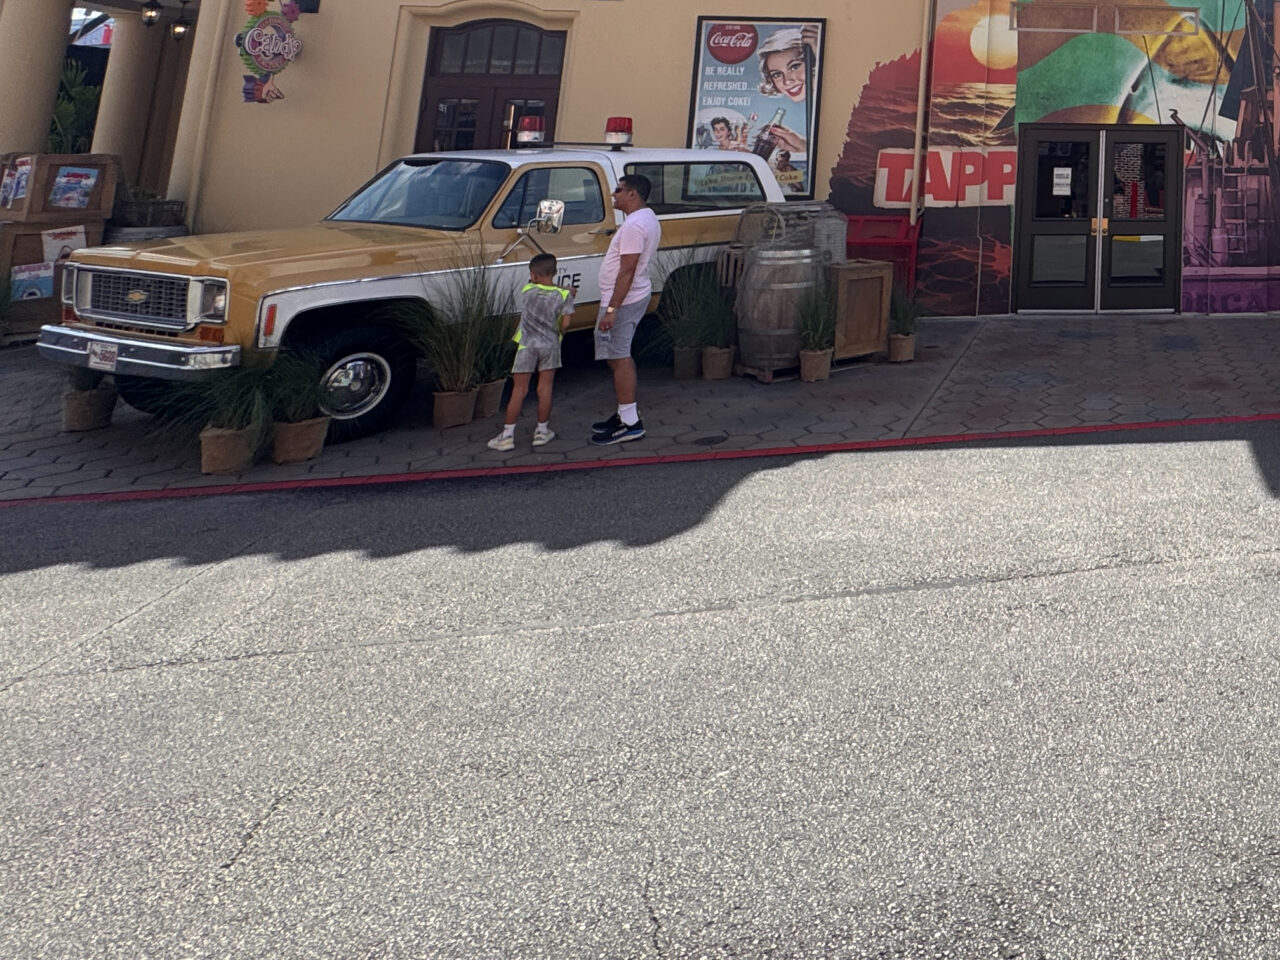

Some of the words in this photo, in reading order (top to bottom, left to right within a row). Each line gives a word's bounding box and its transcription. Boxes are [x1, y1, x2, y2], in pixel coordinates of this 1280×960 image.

[245, 28, 302, 61] Candy
[705, 66, 714, 76] BE
[717, 66, 745, 76] REALLY
[702, 96, 725, 106] ENJOY
[727, 96, 751, 106] COKE!
[878, 151, 1017, 202] TAPP
